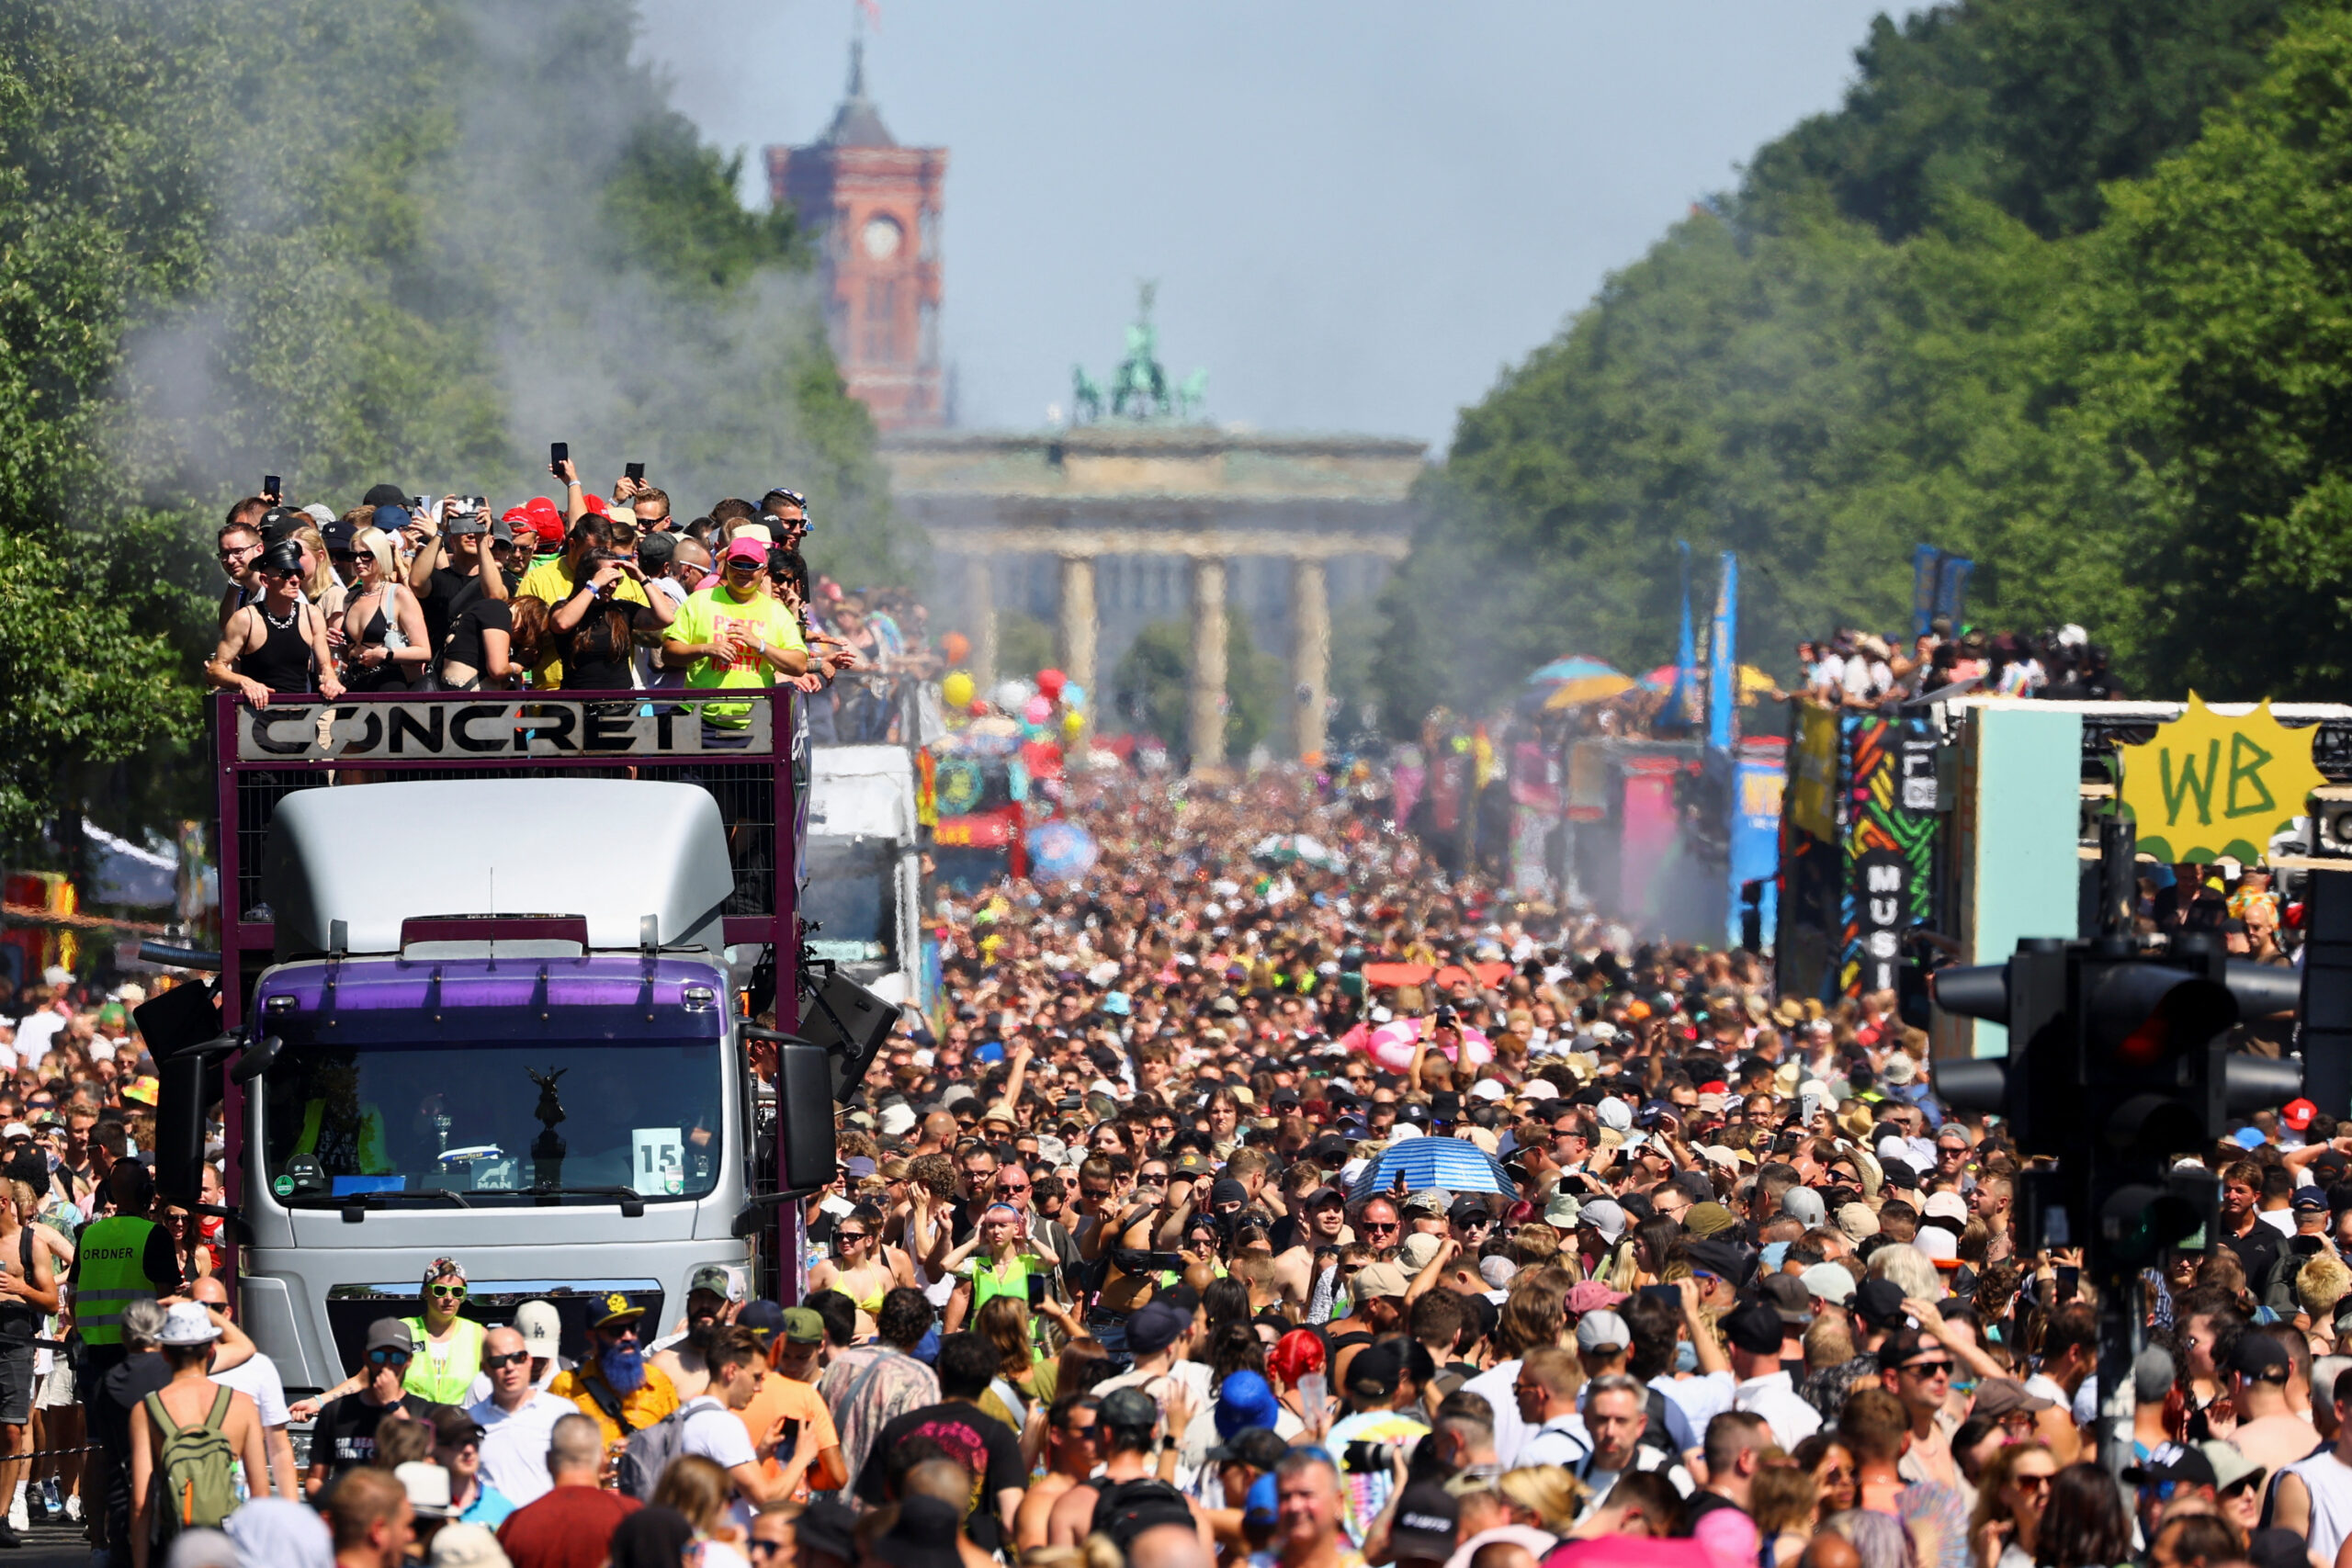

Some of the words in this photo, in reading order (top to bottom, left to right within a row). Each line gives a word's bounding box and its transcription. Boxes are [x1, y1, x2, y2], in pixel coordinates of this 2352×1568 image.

[252, 703, 754, 754] CONCRETE
[2160, 731, 2277, 827] WB
[641, 1145, 676, 1174] 15
[477, 1181, 512, 1190] MAN
[83, 1247, 133, 1260] ORDNER
